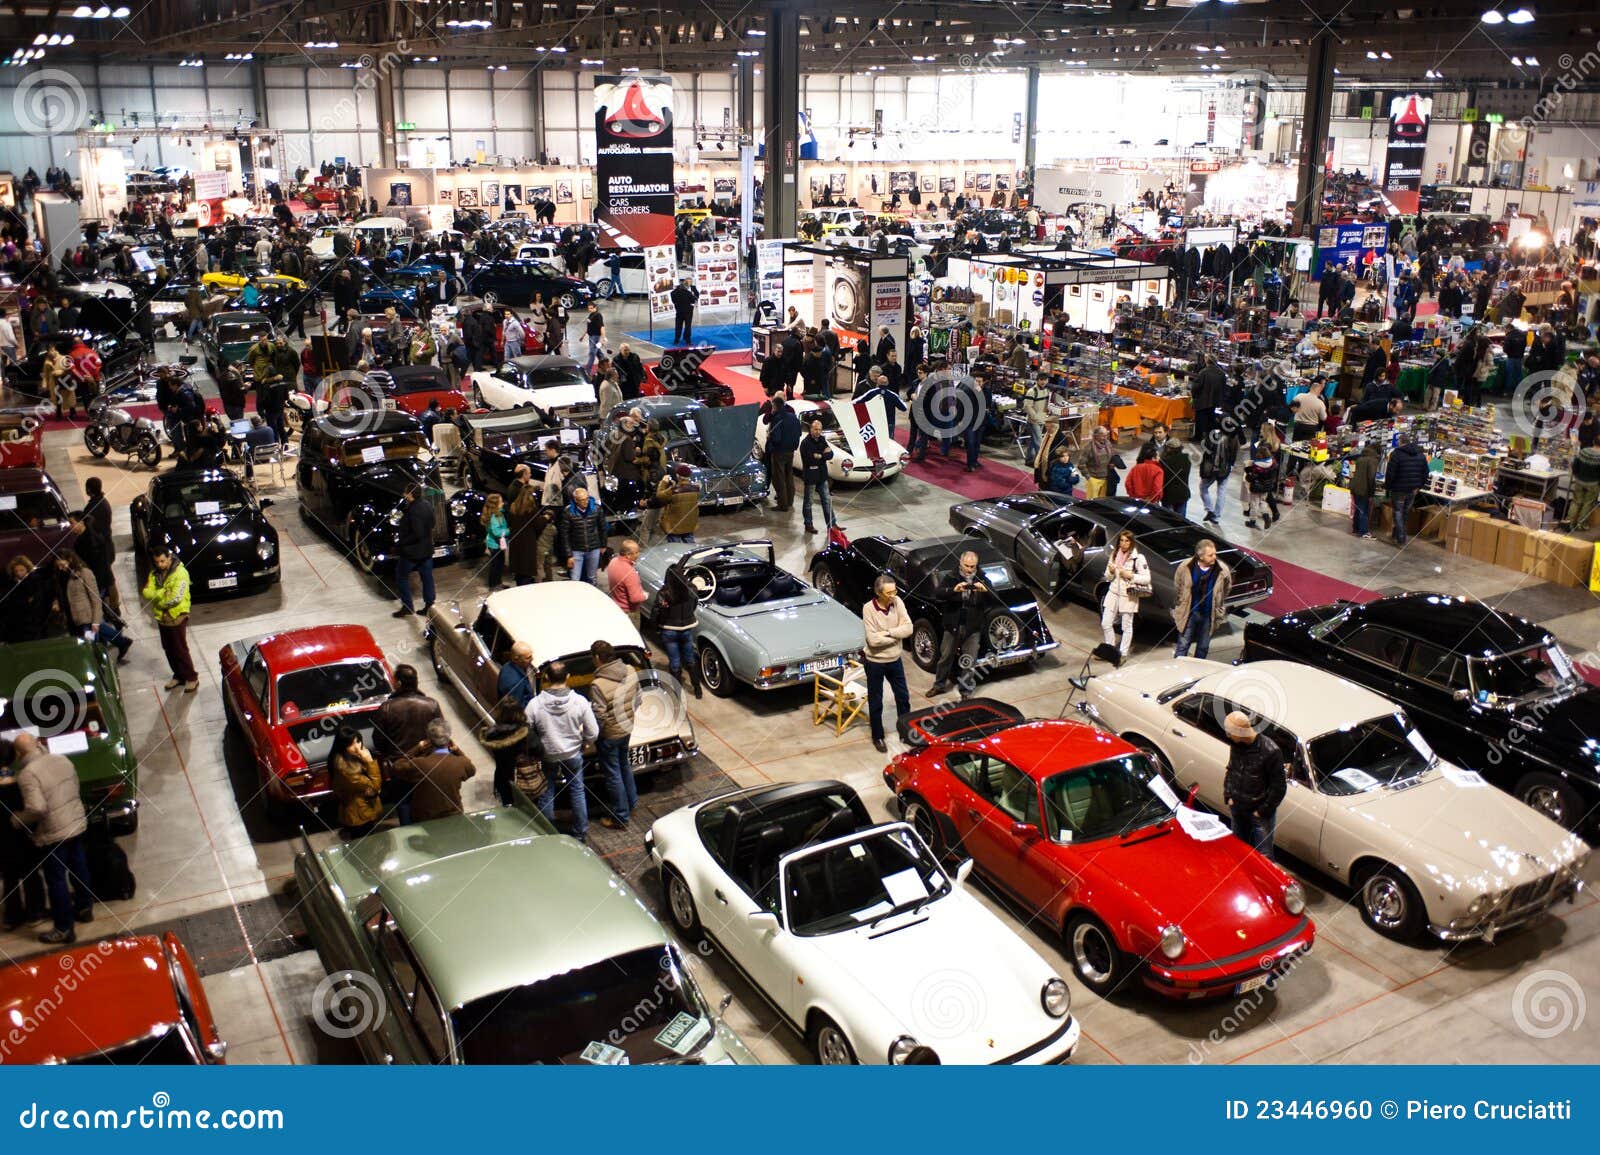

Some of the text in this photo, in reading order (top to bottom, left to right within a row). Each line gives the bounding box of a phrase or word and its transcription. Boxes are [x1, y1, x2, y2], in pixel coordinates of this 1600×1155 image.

[1472, 140, 1486, 158] G
[608, 176, 632, 185] AUTO
[608, 184, 670, 194] RESTAURATORI
[610, 198, 629, 207] CARS
[610, 206, 650, 215] RESTORERS
[860, 424, 876, 440] 59
